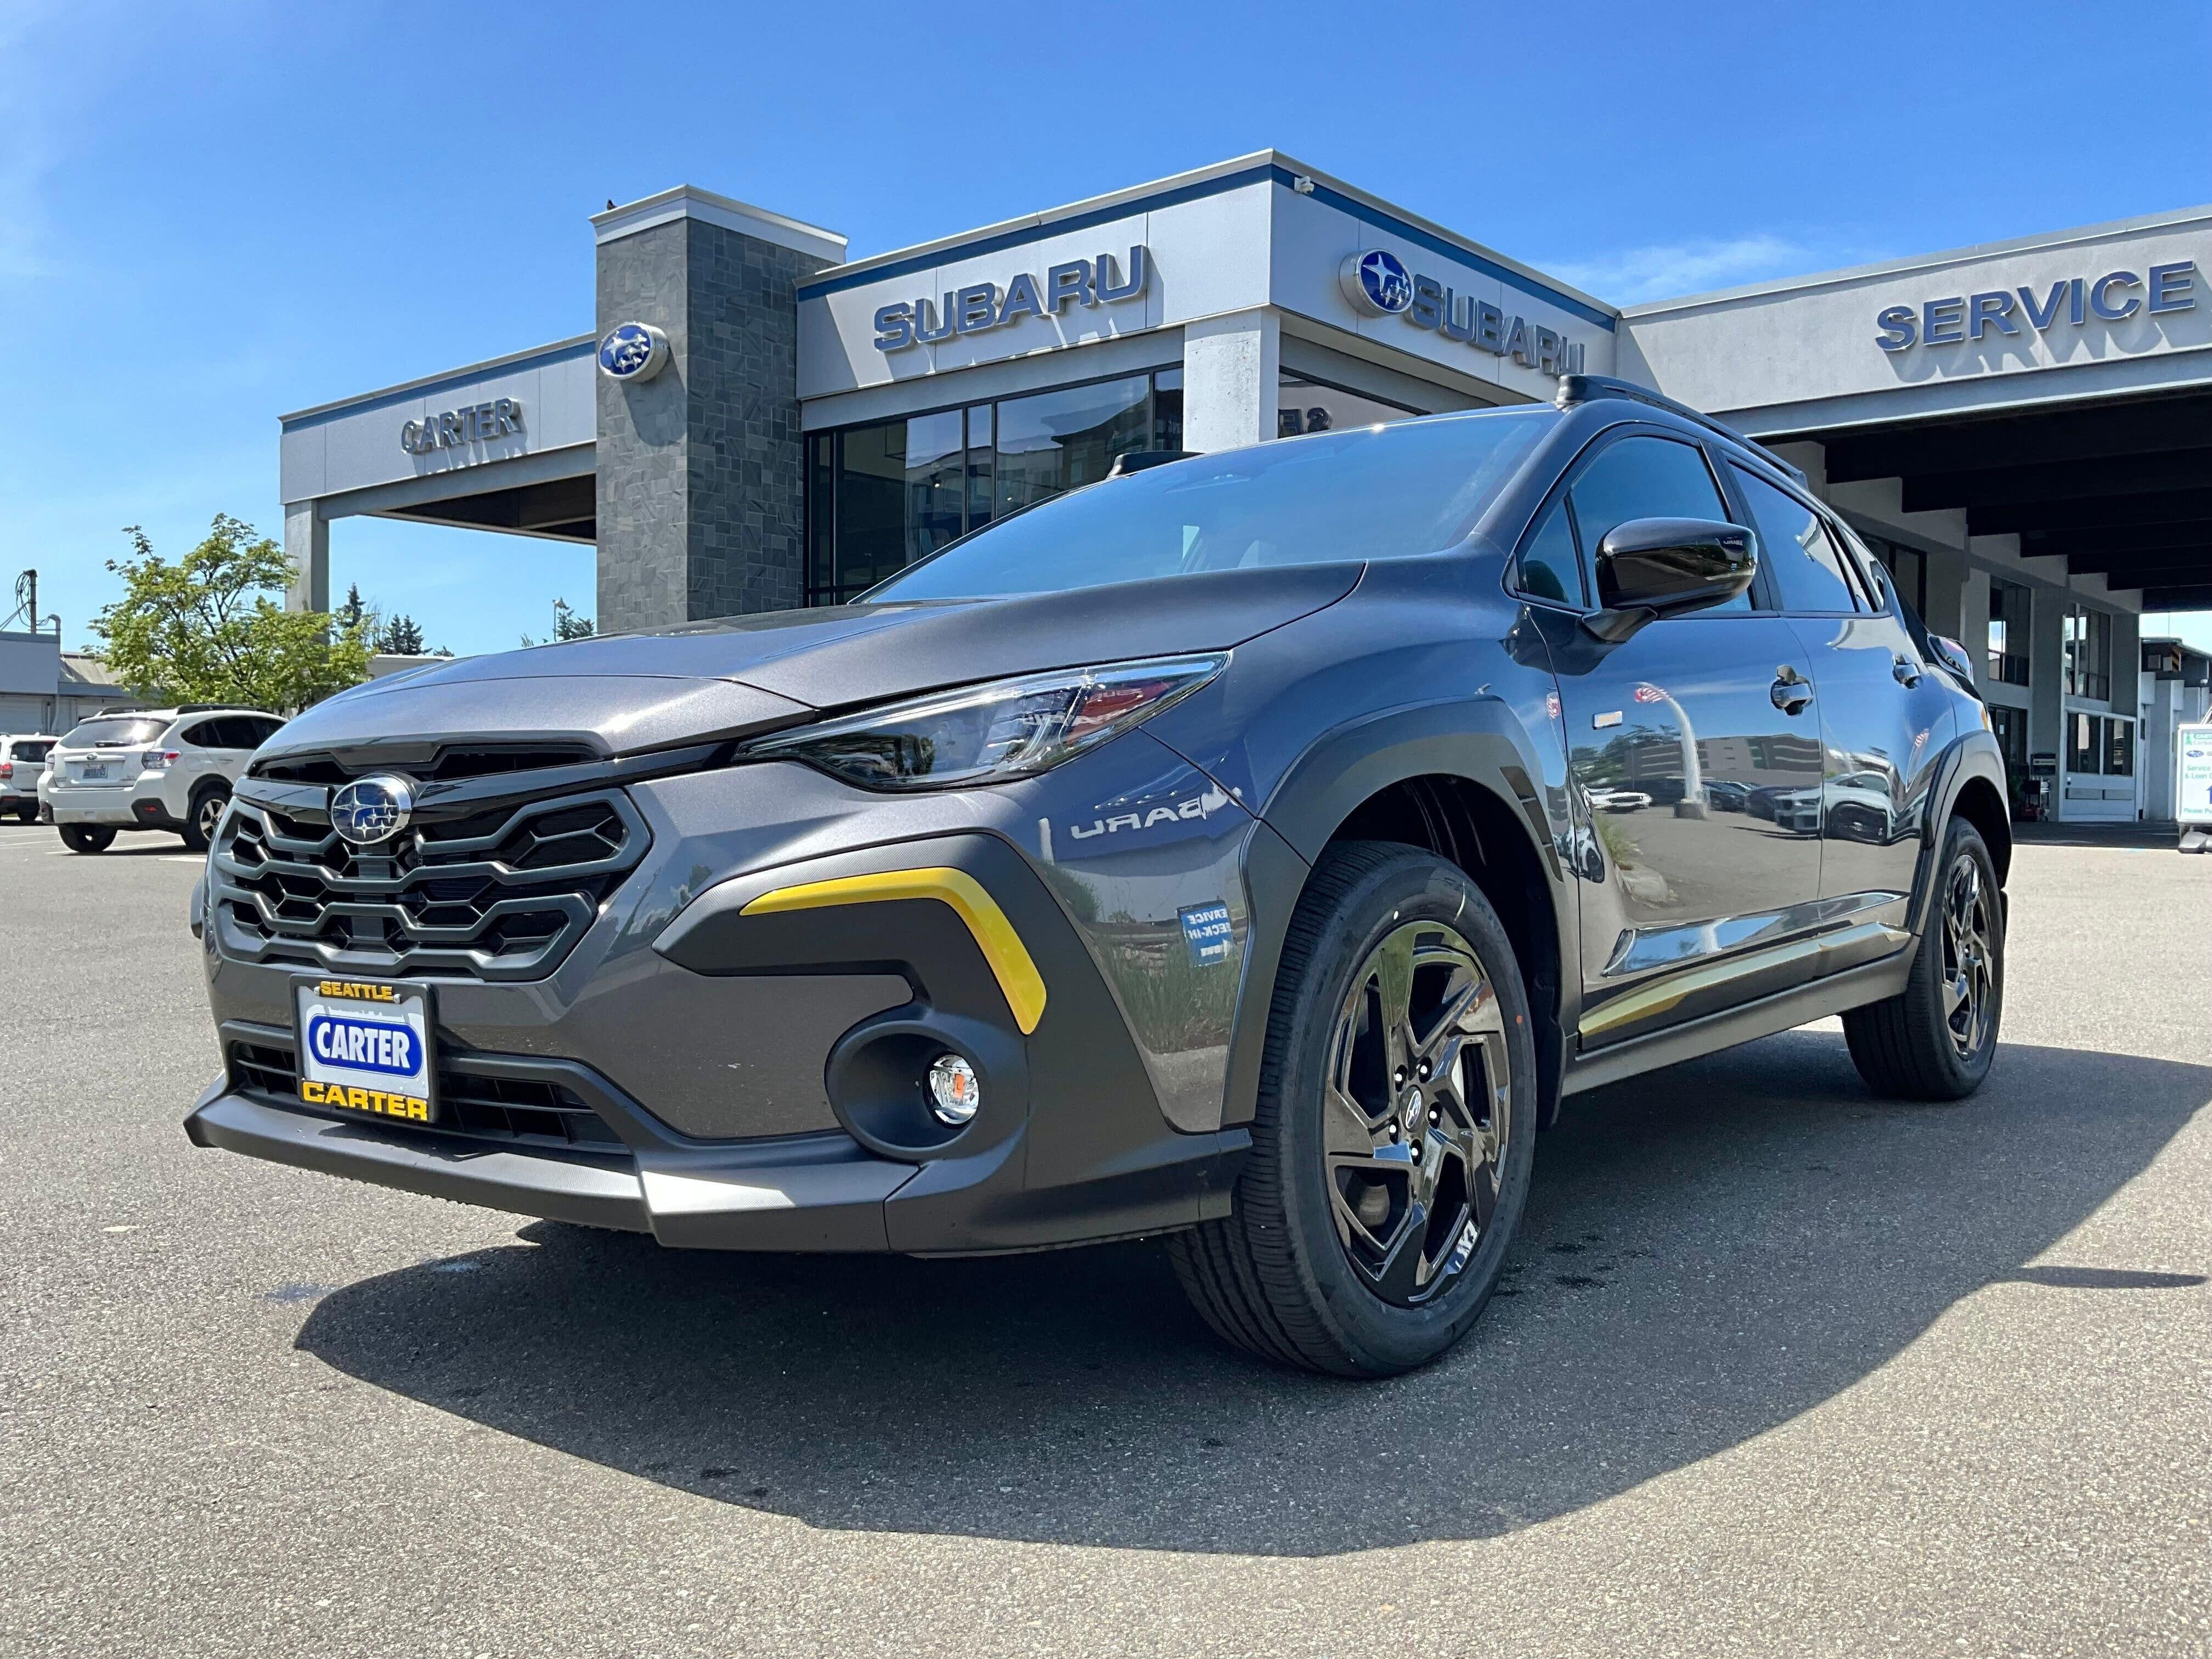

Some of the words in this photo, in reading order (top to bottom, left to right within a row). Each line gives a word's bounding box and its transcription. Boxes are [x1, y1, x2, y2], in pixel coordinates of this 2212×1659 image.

[874, 245, 1148, 352] SUBARU
[1411, 273, 1585, 377] SUBARU
[1875, 260, 2195, 351] SERVICE
[401, 398, 518, 454] CARTER
[319, 980, 394, 1001] SEATTLE
[317, 1022, 410, 1068] CARTER
[302, 1081, 428, 1121] CARTER
